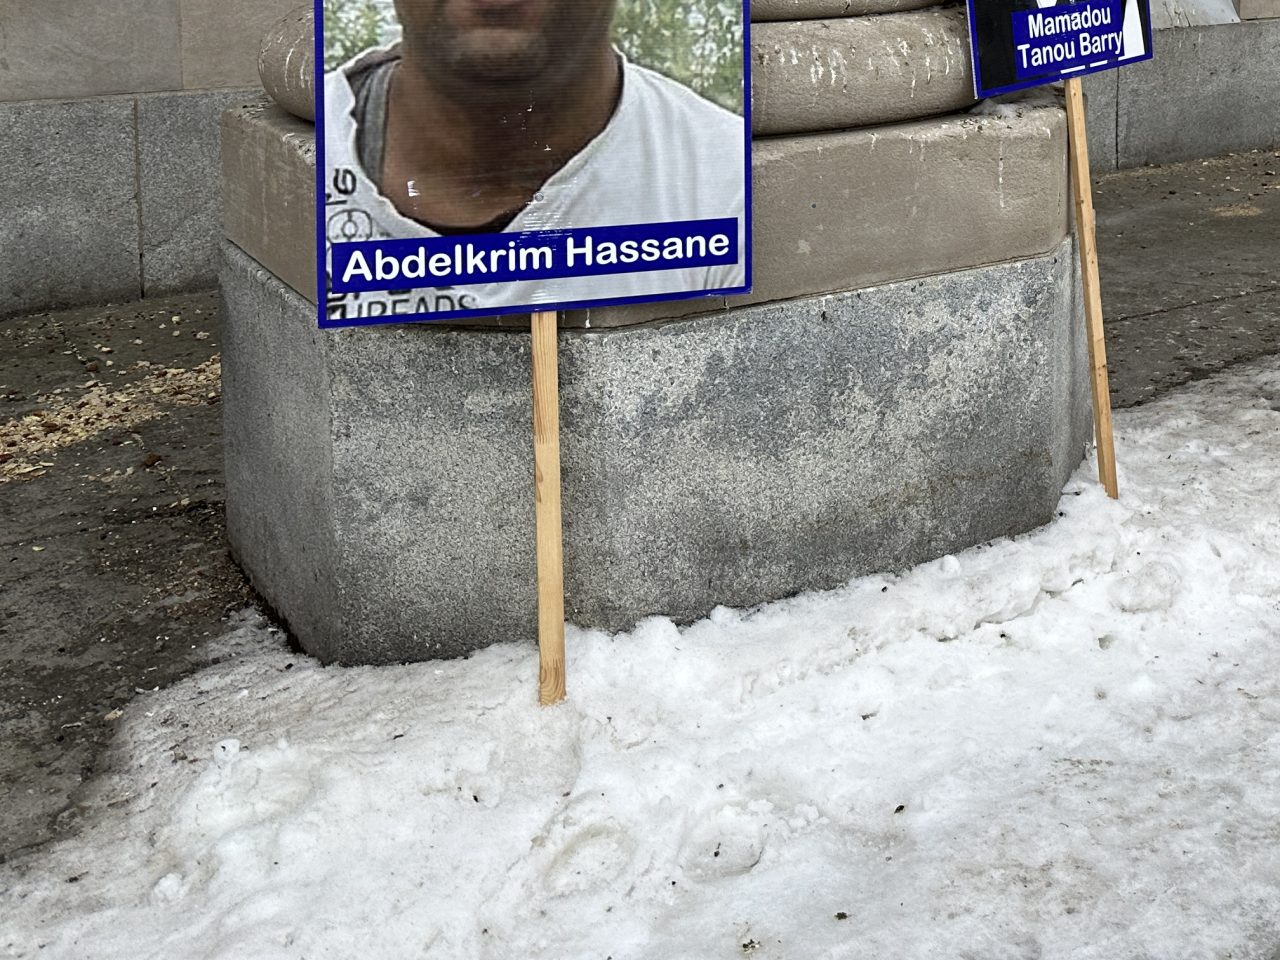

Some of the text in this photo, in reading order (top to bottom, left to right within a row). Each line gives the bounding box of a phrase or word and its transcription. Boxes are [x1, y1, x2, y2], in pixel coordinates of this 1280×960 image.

[1028, 5, 1111, 38] Mamadou
[1017, 30, 1123, 68] Tanou Barry
[342, 233, 730, 283] Abdelkrim Hassane
